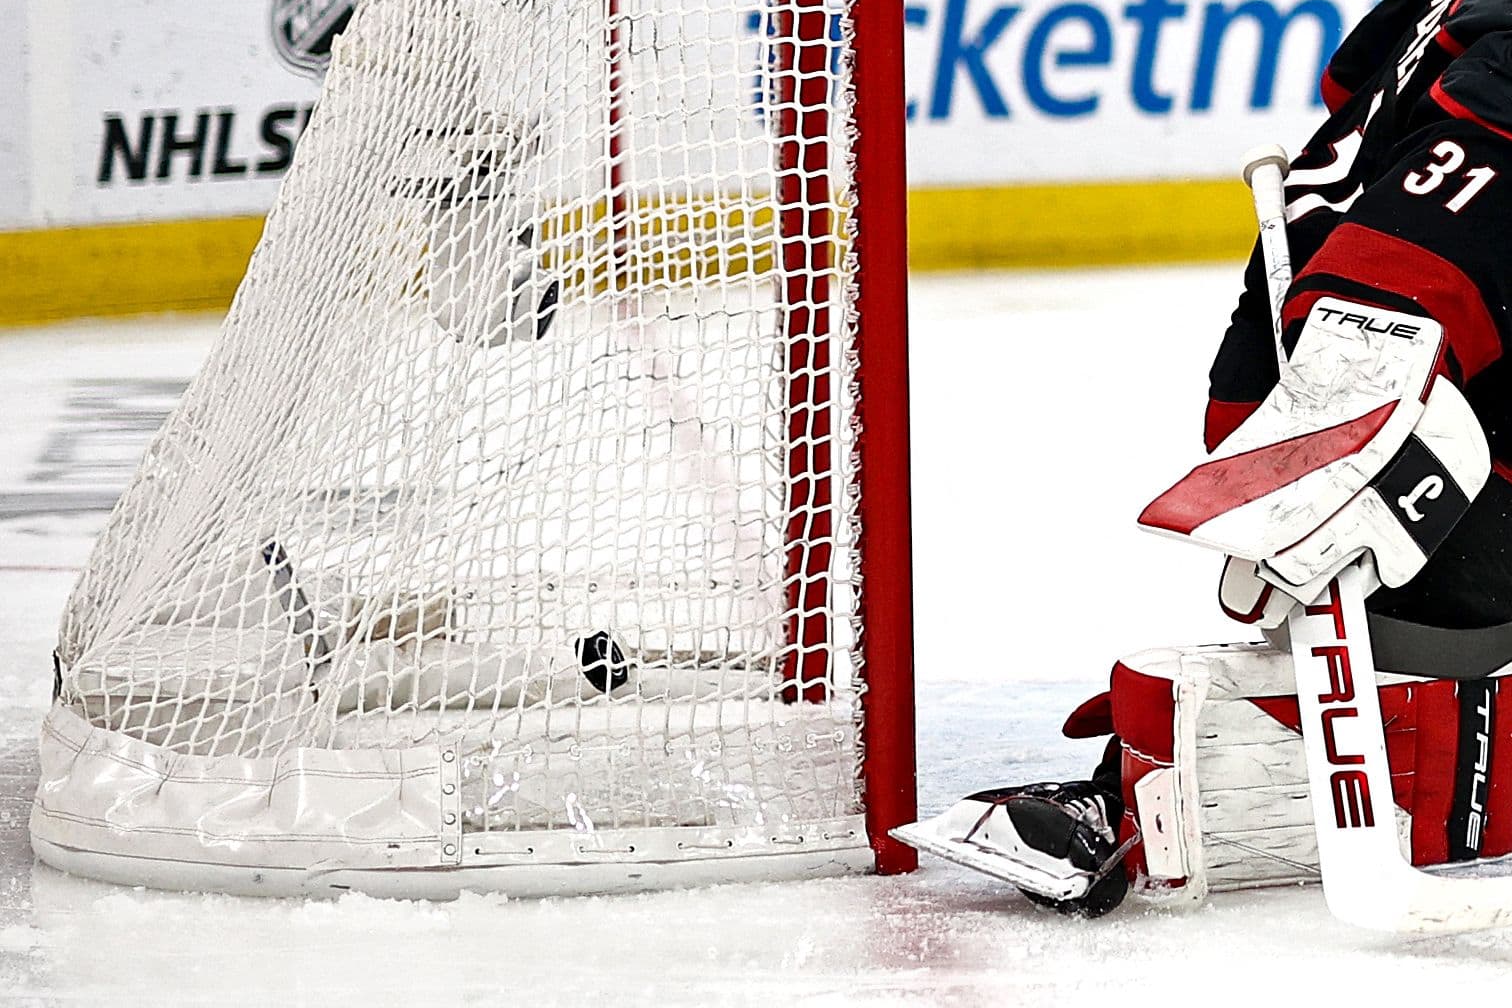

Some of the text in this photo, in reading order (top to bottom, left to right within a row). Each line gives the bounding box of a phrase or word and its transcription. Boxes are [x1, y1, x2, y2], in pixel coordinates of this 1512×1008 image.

[1402, 139, 1497, 214] 31
[1317, 306, 1421, 340] TRUE
[1304, 575, 1376, 829] TRUE
[1465, 688, 1490, 851] TRUE
